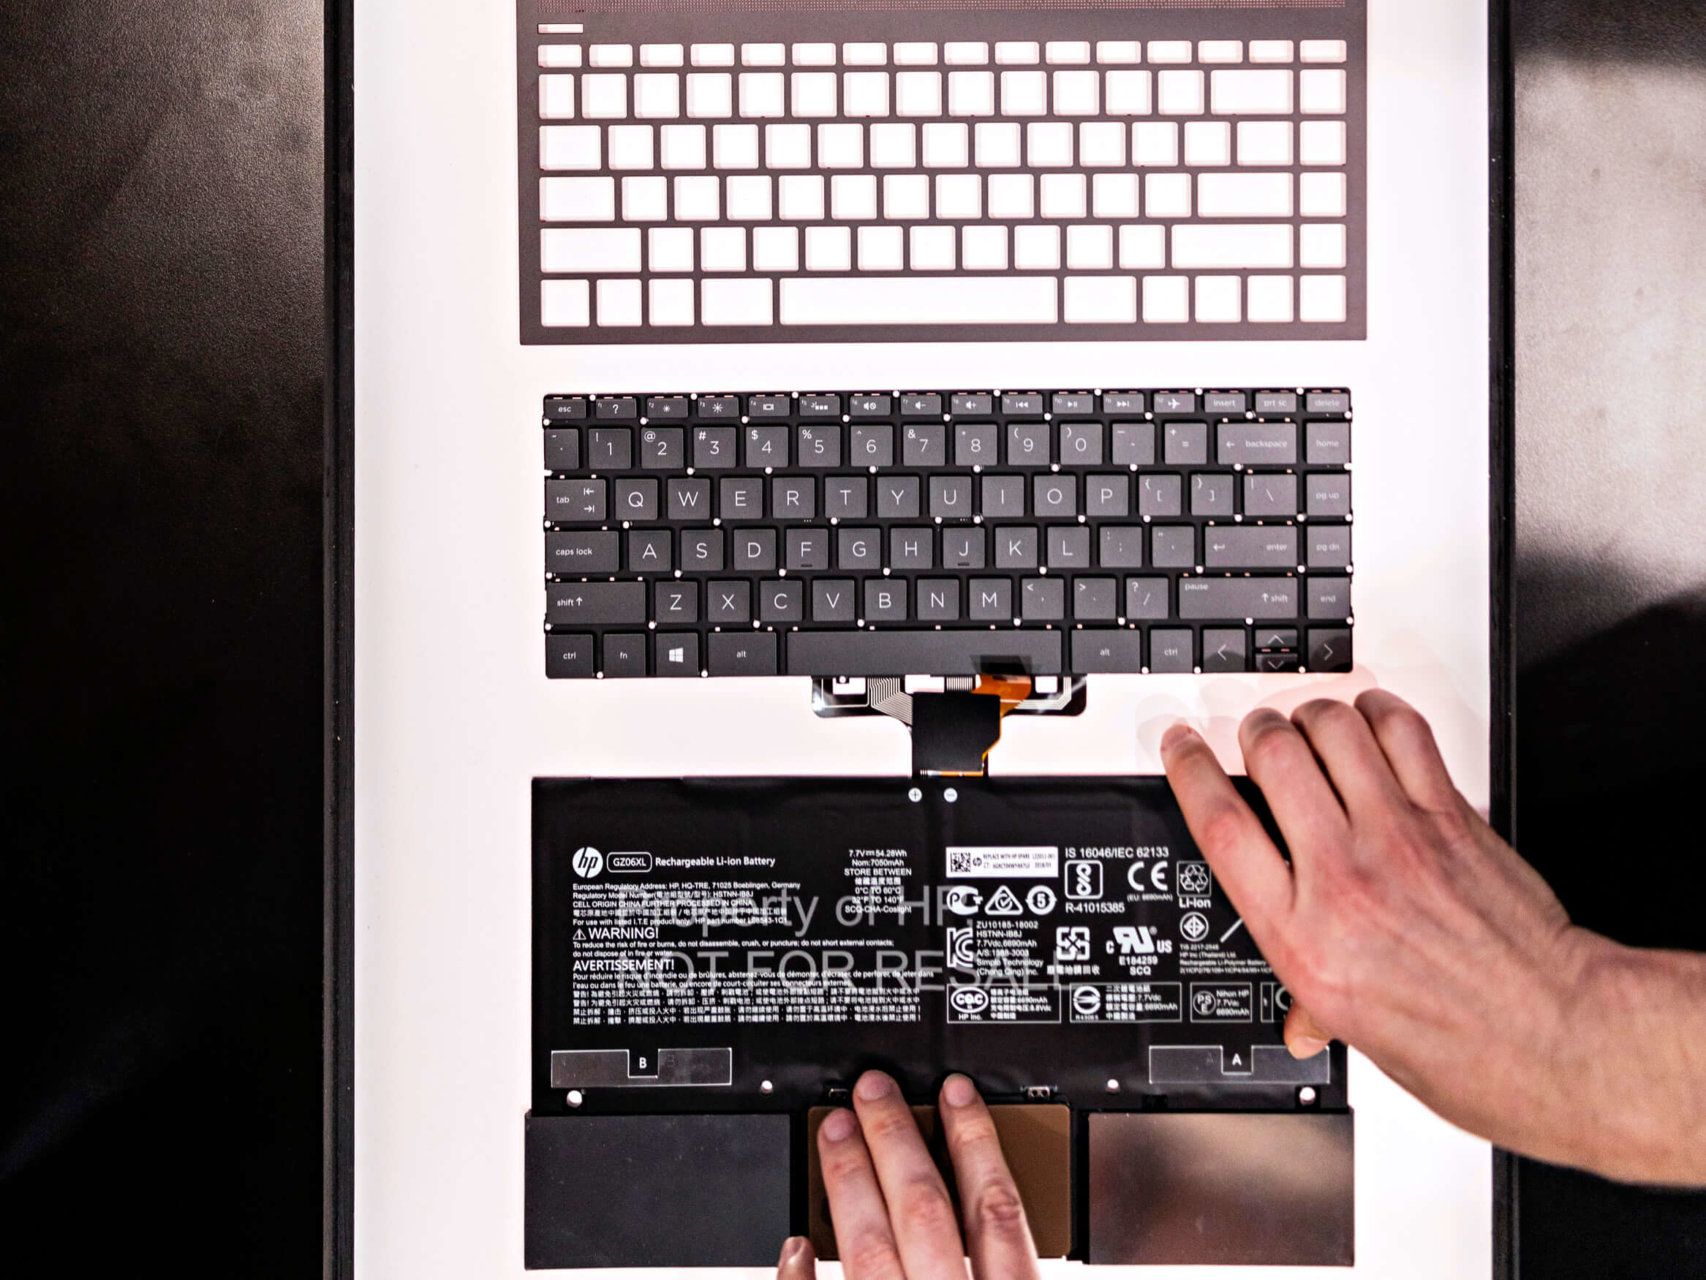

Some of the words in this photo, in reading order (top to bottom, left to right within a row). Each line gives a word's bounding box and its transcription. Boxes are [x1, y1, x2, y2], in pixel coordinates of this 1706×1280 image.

[1263, 400, 1273, 408] prt
[1315, 399, 1340, 407] delete
[608, 443, 612, 455] 1
[658, 442, 666, 455] 2
[710, 441, 719, 454] 3
[762, 441, 772, 453] 4
[815, 440, 824, 453] 5
[866, 440, 876, 453] 6
[920, 439, 928, 452] 7
[971, 439, 981, 452] 8
[1024, 438, 1033, 452] 9
[1076, 438, 1086, 451] 0
[1246, 440, 1287, 448] backspace
[629, 492, 643, 507] Q
[679, 492, 698, 506] W
[736, 491, 746, 506] E
[787, 491, 799, 505] R
[840, 490, 851, 505] T
[892, 490, 904, 505] Y
[944, 490, 956, 504] U
[1047, 488, 1062, 504] O
[1101, 489, 1112, 503] P
[643, 544, 656, 559] A
[697, 543, 707, 558] S
[748, 542, 761, 557] D
[801, 542, 811, 557] F
[853, 541, 866, 557] G
[905, 542, 917, 556] H
[959, 541, 968, 556] J
[1010, 541, 1021, 555] K
[1063, 541, 1073, 556] L
[1316, 544, 1328, 552] pg
[670, 595, 681, 610] Z
[722, 595, 734, 609] X
[774, 594, 787, 609] C
[827, 593, 839, 608] V
[879, 593, 891, 608] B
[931, 593, 944, 607] N
[983, 592, 996, 607] M
[1100, 648, 1109, 656] alt
[1065, 848, 1076, 858] IS
[1080, 848, 1134, 858] 16046/IEC
[1136, 847, 1169, 858] 62133
[573, 847, 603, 878] hp
[613, 858, 647, 867] GZ06XL
[655, 857, 714, 868] Rechargeable
[716, 856, 742, 866] Li-ion
[743, 856, 776, 868] Battery
[844, 868, 871, 876] STORE
[873, 868, 912, 876] BETWEEN
[1127, 861, 1168, 892] CE
[573, 883, 604, 891] European
[605, 883, 638, 892] Regulatory
[772, 881, 801, 890] Germany
[573, 900, 591, 908] CELL
[592, 900, 617, 908] ORIGIN
[1065, 902, 1126, 913] R-41015385
[619, 886, 819, 938] Property
[836, 884, 881, 927] of
[588, 927, 659, 939] WARNING!
[1156, 940, 1173, 953] US
[573, 960, 675, 971] AVERTISSEMENT!
[1119, 956, 1158, 966] E184259
[619, 950, 729, 992] NOT
[747, 950, 855, 991] FOR
[1130, 966, 1152, 976] SCQ
[639, 1057, 647, 1068] B
[1231, 1053, 1243, 1066] A
